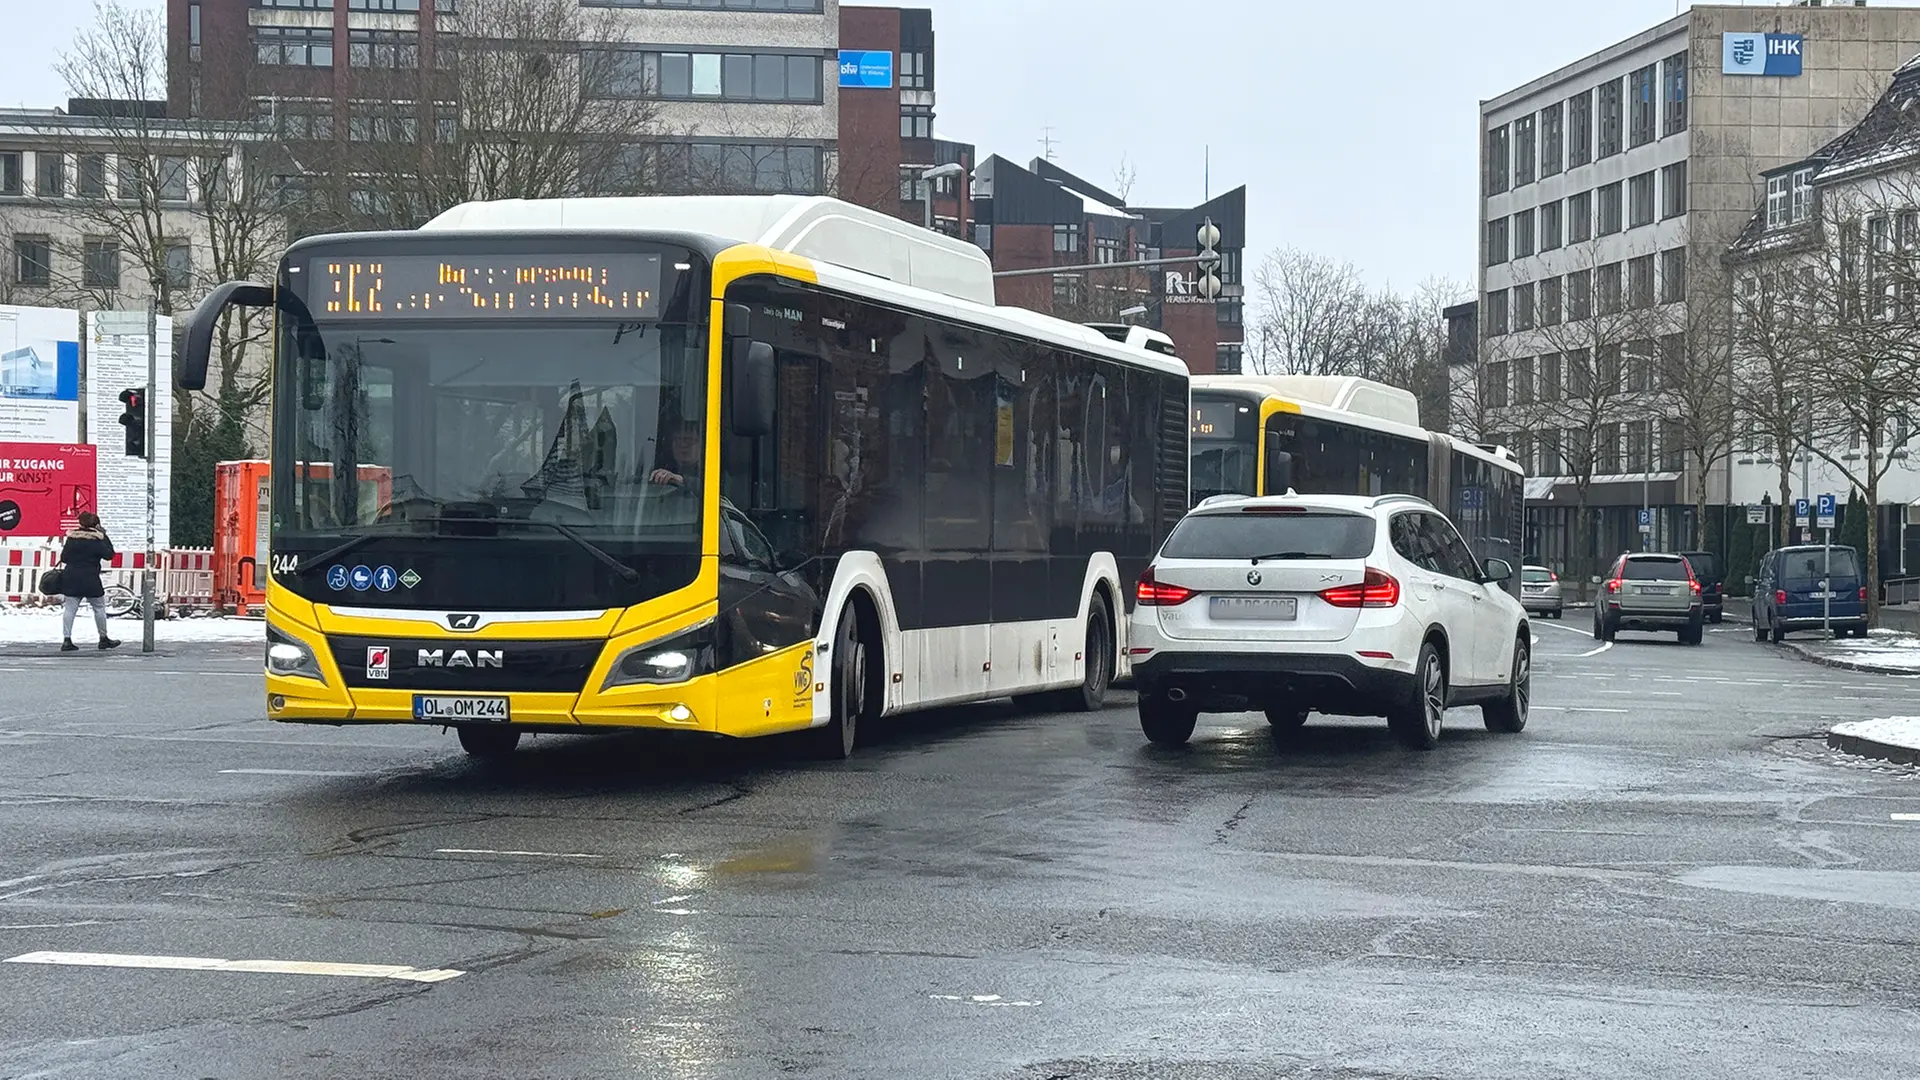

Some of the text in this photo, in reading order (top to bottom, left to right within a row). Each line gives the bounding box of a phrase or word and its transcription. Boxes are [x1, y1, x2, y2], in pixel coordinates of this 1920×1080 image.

[1768, 39, 1801, 55] IHK
[1165, 271, 1197, 294] R+
[784, 307, 803, 322] MAN
[0, 459, 64, 470] R ZUGANG
[16, 472, 52, 484] KUNST!
[1798, 501, 1807, 515] P
[1819, 497, 1830, 514] P
[272, 554, 299, 575] 244
[417, 648, 504, 668] MAN
[368, 669, 388, 678] VBN
[424, 699, 505, 716] OL OM 244
